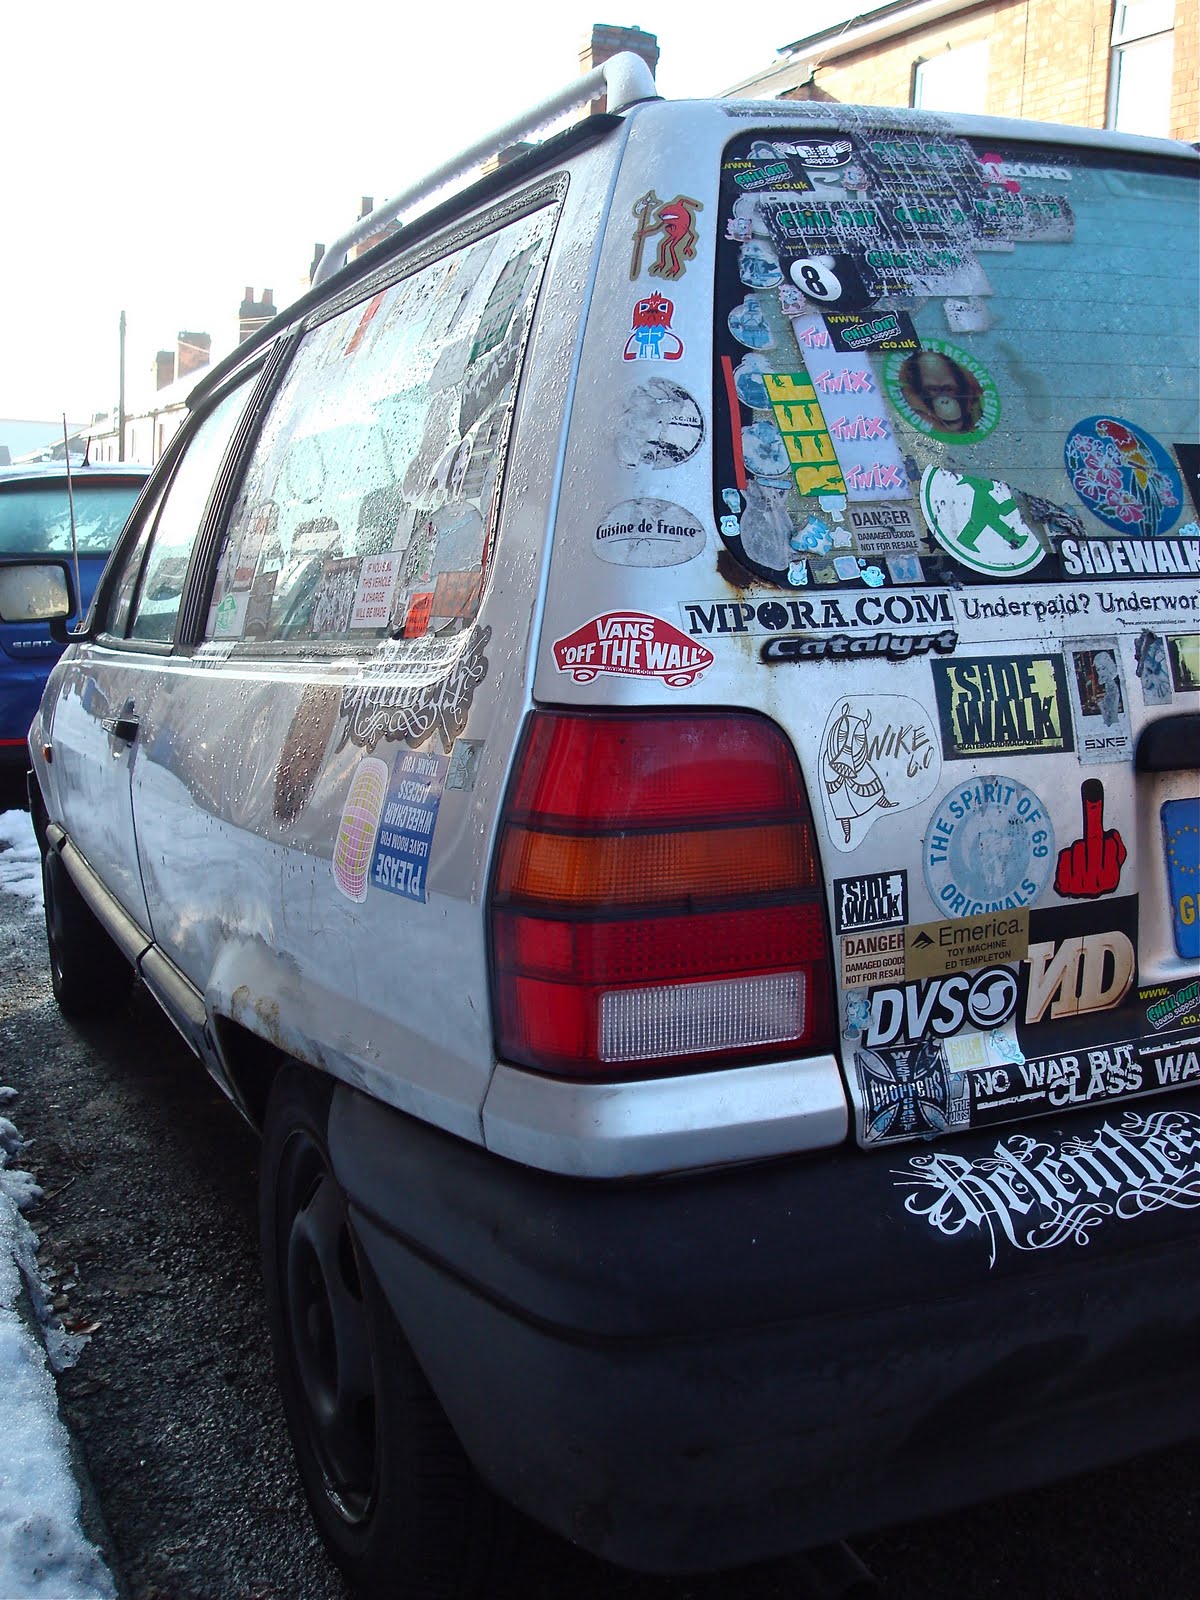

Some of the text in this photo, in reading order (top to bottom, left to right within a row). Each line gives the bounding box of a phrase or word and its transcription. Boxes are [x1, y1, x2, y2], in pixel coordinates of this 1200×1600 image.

[800, 265, 828, 297] 8
[827, 316, 863, 324] www.
[873, 316, 897, 332] OUT
[800, 326, 832, 349] Tw
[880, 339, 917, 349] .co.uk
[763, 374, 848, 496] REEF
[596, 518, 697, 540] Cuisine de France
[852, 510, 911, 527] DANGER
[857, 530, 916, 542] DAMAGED GOODS
[860, 540, 919, 552] NOT FOR RESALE
[684, 593, 954, 635] MPORA.COM
[961, 590, 1200, 623] Underpaid? Underwor
[12, 640, 52, 648] SEAT
[596, 617, 655, 641] VANS
[600, 639, 641, 669] THE
[765, 631, 958, 661] Catalyst
[952, 661, 1045, 702] SIDE
[955, 696, 1061, 744] WALK
[867, 723, 930, 761] NIKE
[906, 745, 935, 778] 6.0
[397, 779, 432, 804] ACCESS
[384, 801, 434, 835] WHEELCHAIR
[930, 817, 956, 866] THE
[949, 783, 1015, 820] SPIRIT
[1016, 796, 1042, 826] OF
[375, 853, 423, 897] PLEASE
[845, 876, 891, 903] SIDE
[844, 893, 901, 925] WALK
[940, 878, 1036, 918] ORIGINALS
[845, 932, 905, 957] DANGER
[947, 939, 1008, 959] TOY MACHINE
[845, 960, 881, 973] DAMAGED
[945, 949, 1012, 971] ED TEMPLETON
[845, 973, 862, 985] NOT
[863, 970, 878, 983] FOR
[1139, 986, 1170, 1000] www.
[1177, 982, 1200, 1004] OUT
[867, 976, 971, 1048] DVS
[1181, 1013, 1200, 1026] .co.
[890, 1050, 911, 1082] WEST
[1018, 1056, 1081, 1089] WAR
[1153, 1051, 1200, 1086] WA
[972, 1069, 1011, 1099] NO
[1048, 1061, 1144, 1106] CLASS
